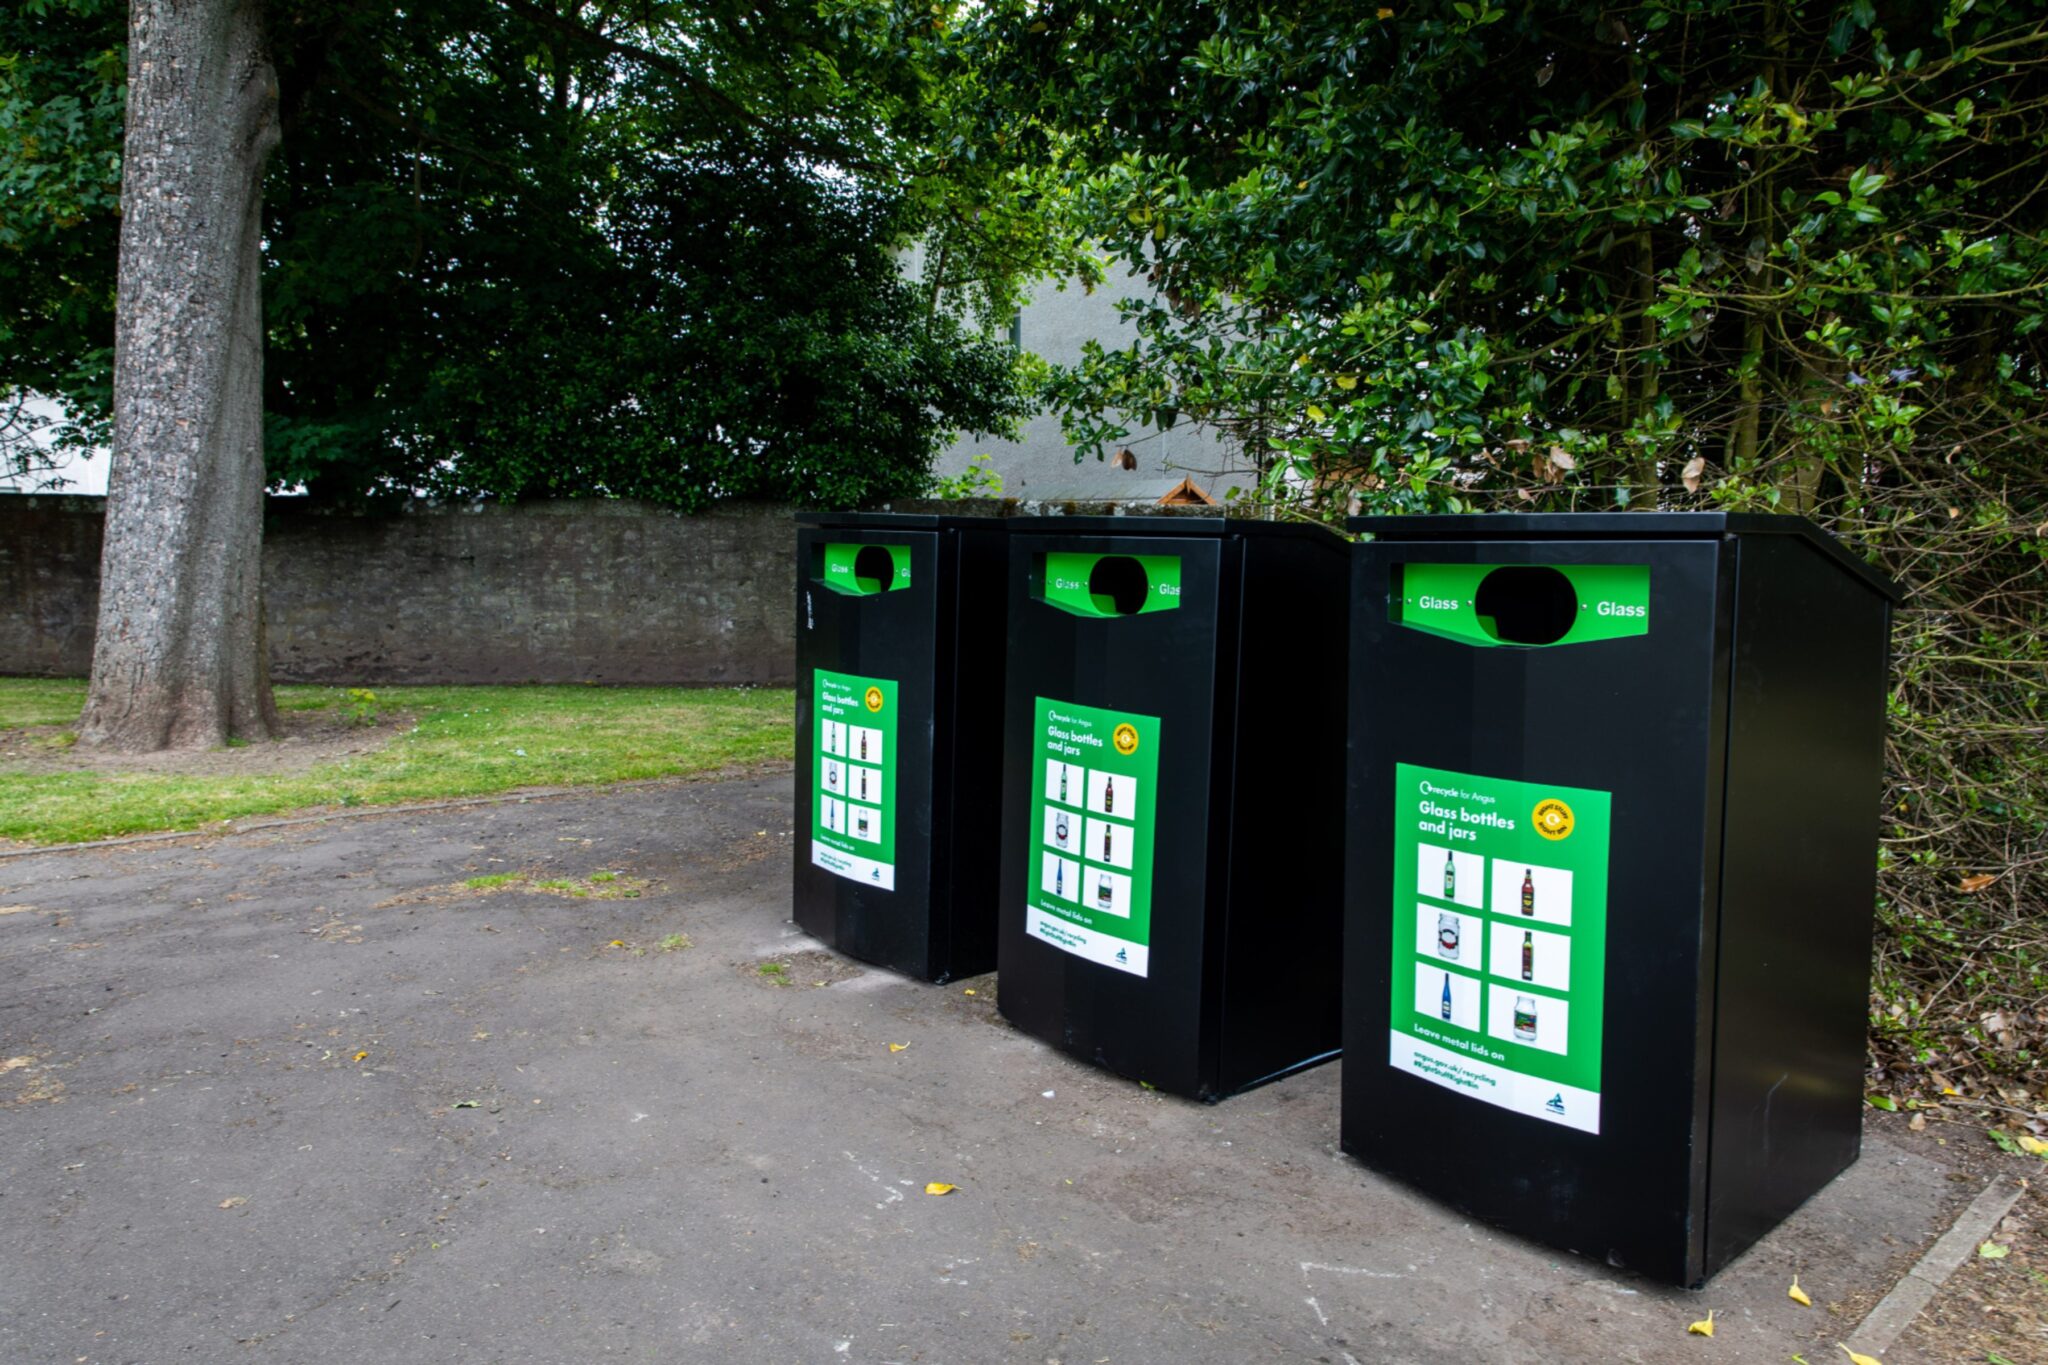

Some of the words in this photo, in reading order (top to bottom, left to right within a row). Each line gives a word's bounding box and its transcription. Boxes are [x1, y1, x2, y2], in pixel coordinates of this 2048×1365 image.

[1055, 578, 1079, 590] Glass
[1419, 596, 1459, 610] Glass
[1597, 601, 1646, 617] Glass
[1047, 725, 1070, 740] Glass
[1070, 730, 1103, 747] bottles
[1047, 741, 1062, 752] and
[1063, 741, 1081, 756] jars
[1431, 785, 1459, 798] recycle
[1460, 789, 1470, 799] for
[1472, 792, 1496, 805] Angus
[1418, 800, 1457, 820] Glass
[1460, 807, 1516, 830] bottles
[1418, 820, 1446, 835] and
[1448, 822, 1477, 841] jars
[1414, 1023, 1441, 1040] Leave
[1442, 1035, 1470, 1050] metal
[1470, 1042, 1490, 1058] lids
[1490, 1052, 1505, 1062] on
